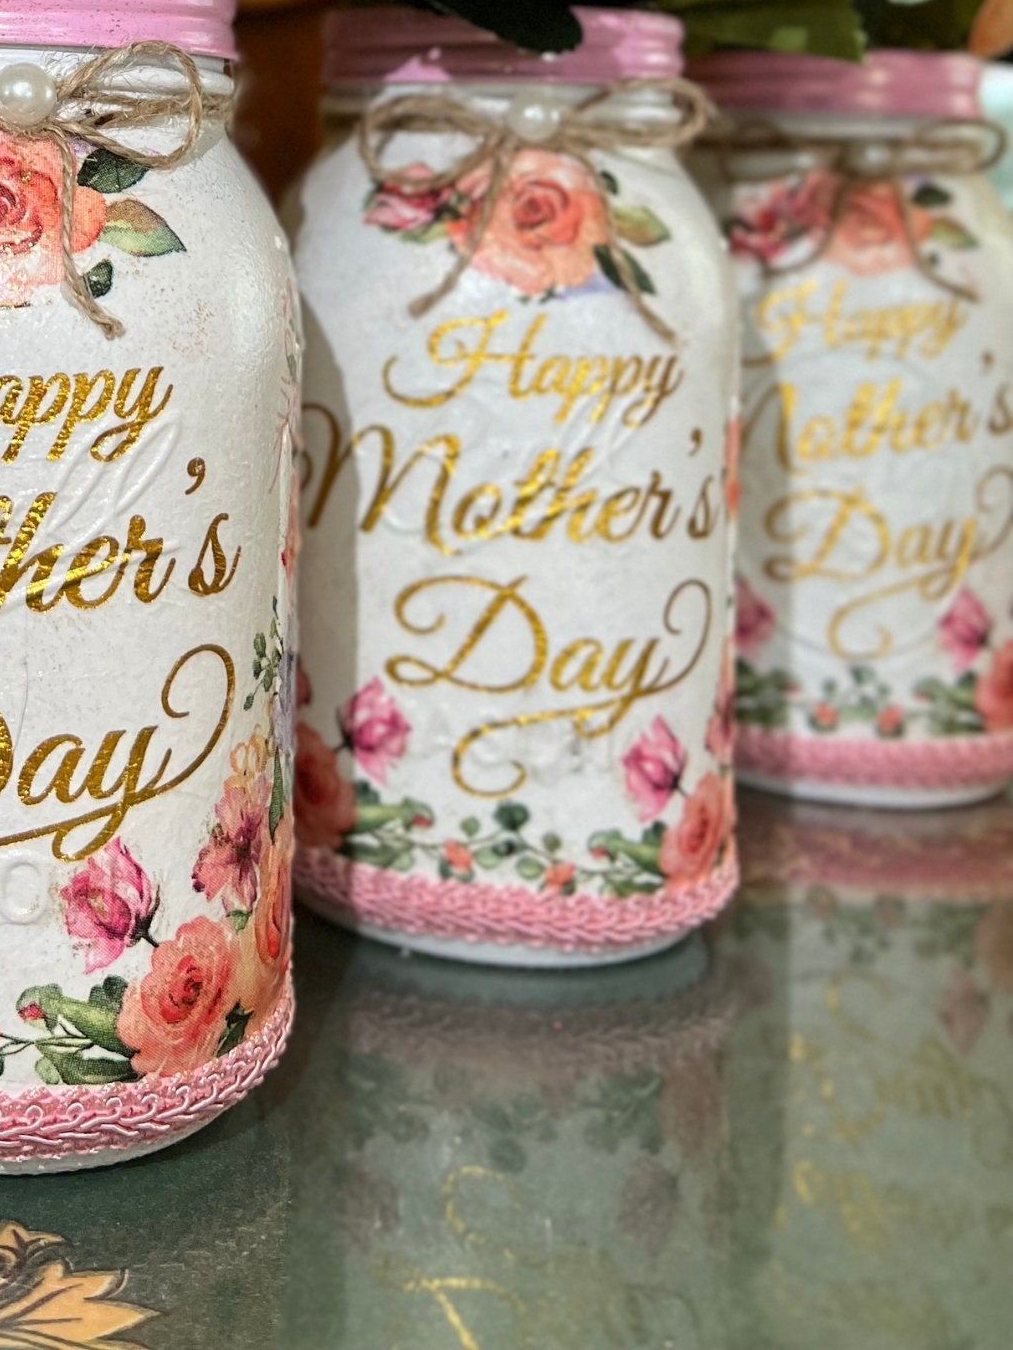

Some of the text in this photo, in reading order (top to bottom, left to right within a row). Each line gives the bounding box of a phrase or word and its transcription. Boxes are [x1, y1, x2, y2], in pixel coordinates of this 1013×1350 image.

[382, 309, 684, 428] Happy
[298, 403, 721, 556] Mother's
[761, 466, 1013, 662] Day
[384, 576, 713, 798] Day
